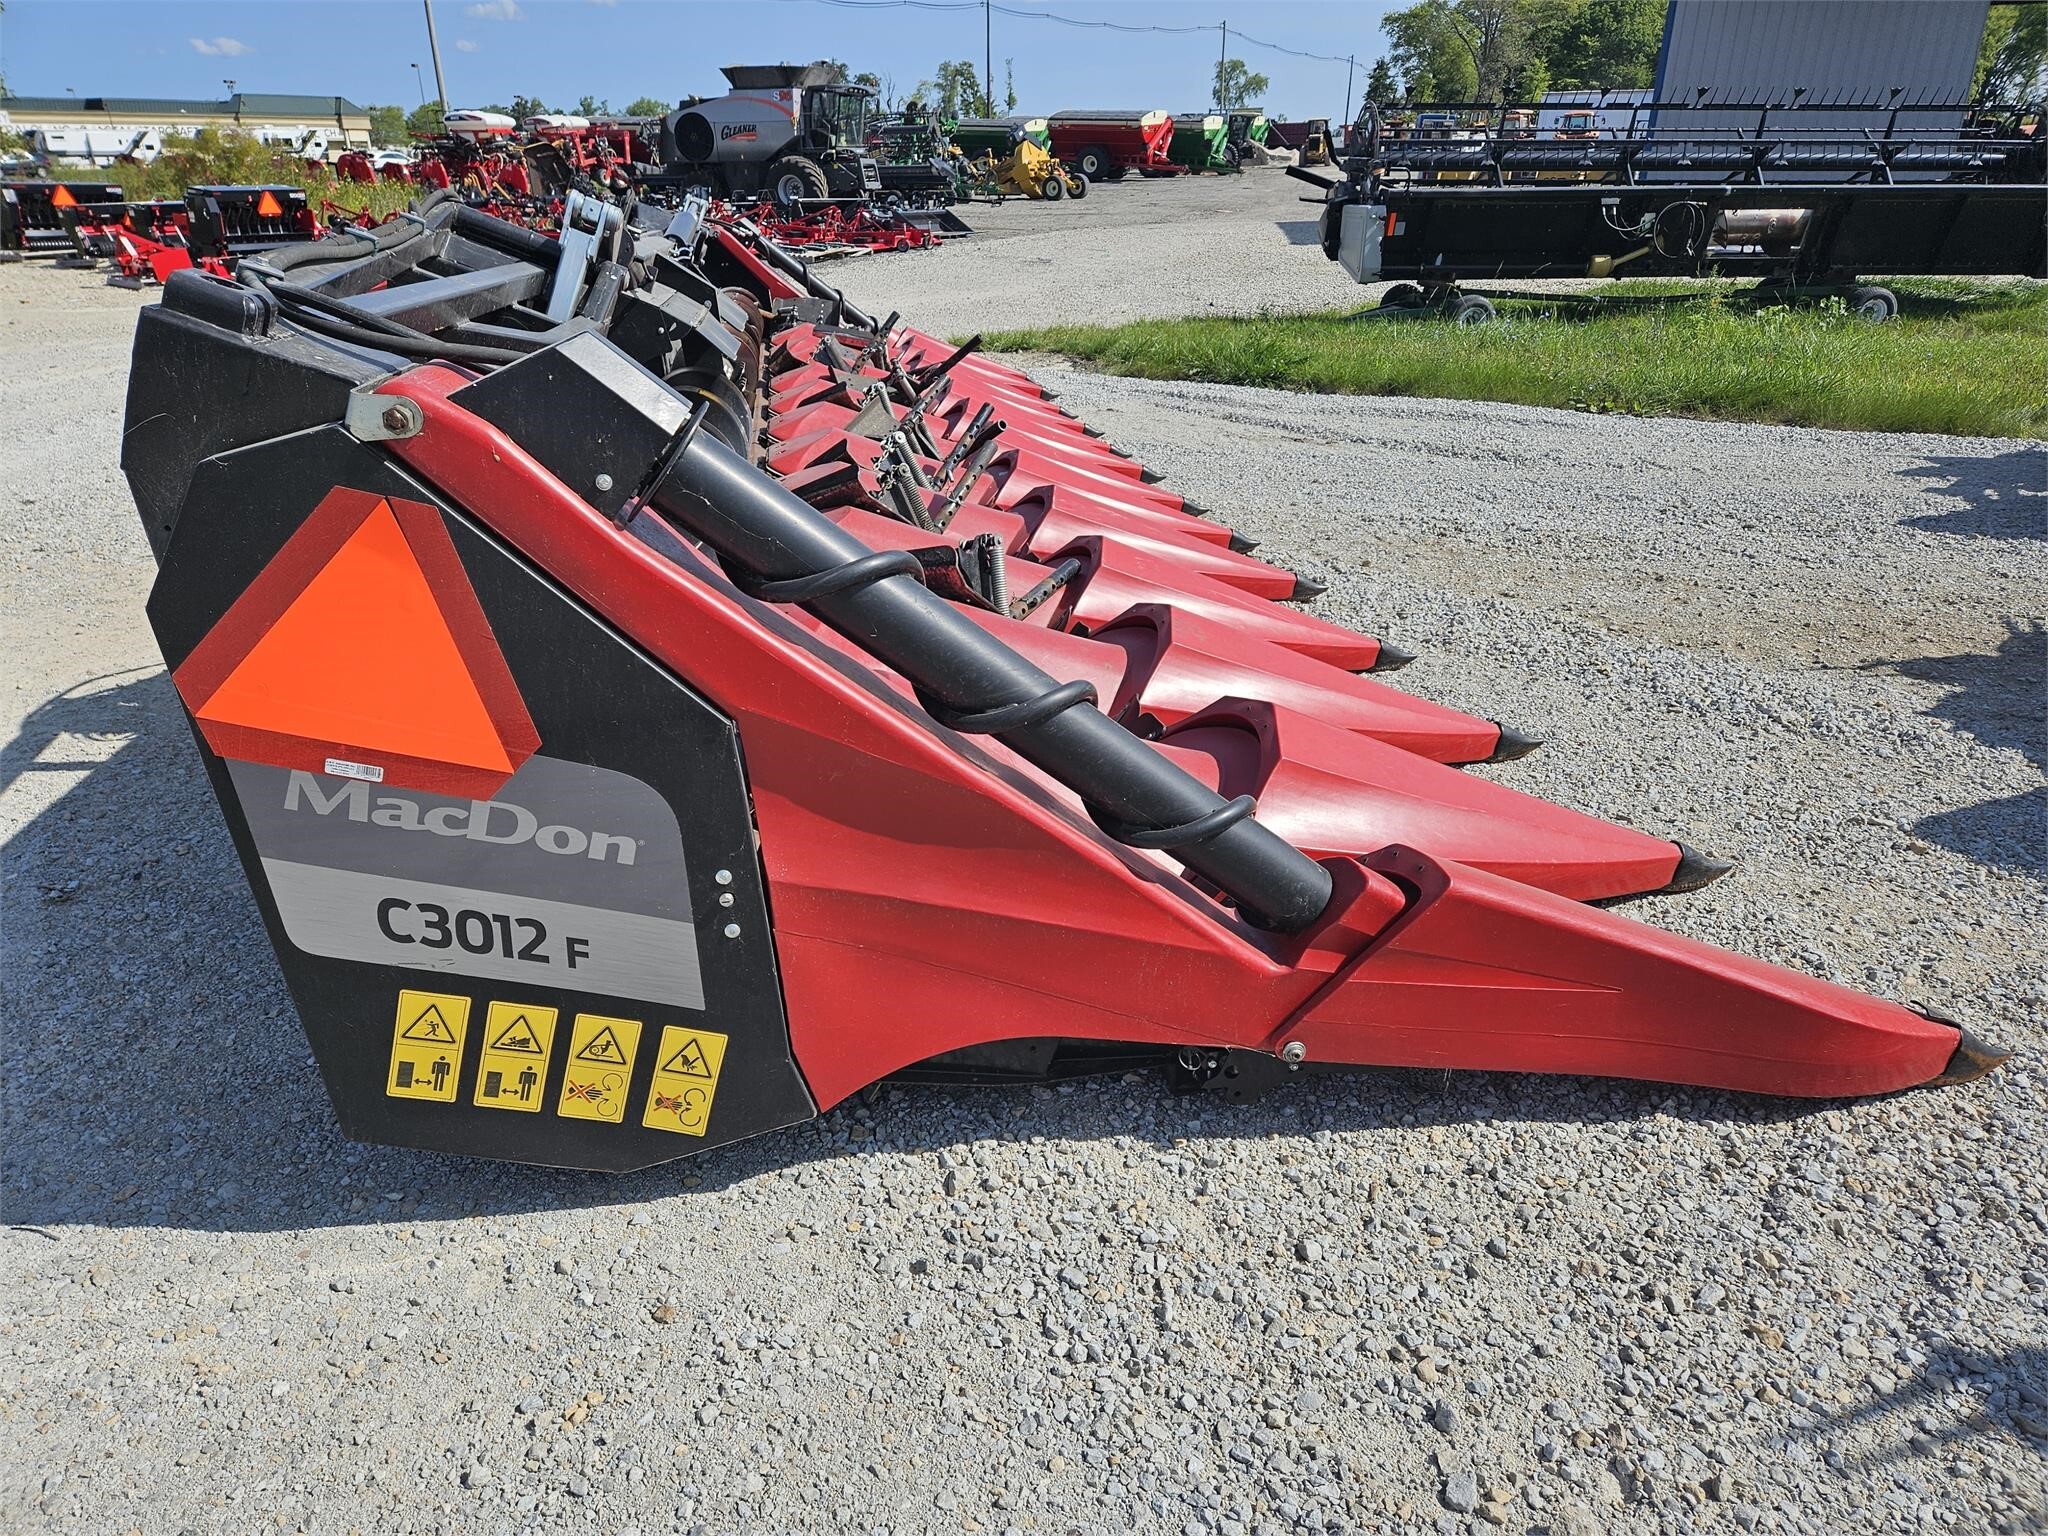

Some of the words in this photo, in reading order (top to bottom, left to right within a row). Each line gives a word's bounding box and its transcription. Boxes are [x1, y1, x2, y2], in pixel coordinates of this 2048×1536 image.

[721, 124, 757, 141] GLEANER
[284, 768, 637, 866] MacDon
[377, 897, 550, 964] C3012
[566, 936, 590, 969] F
